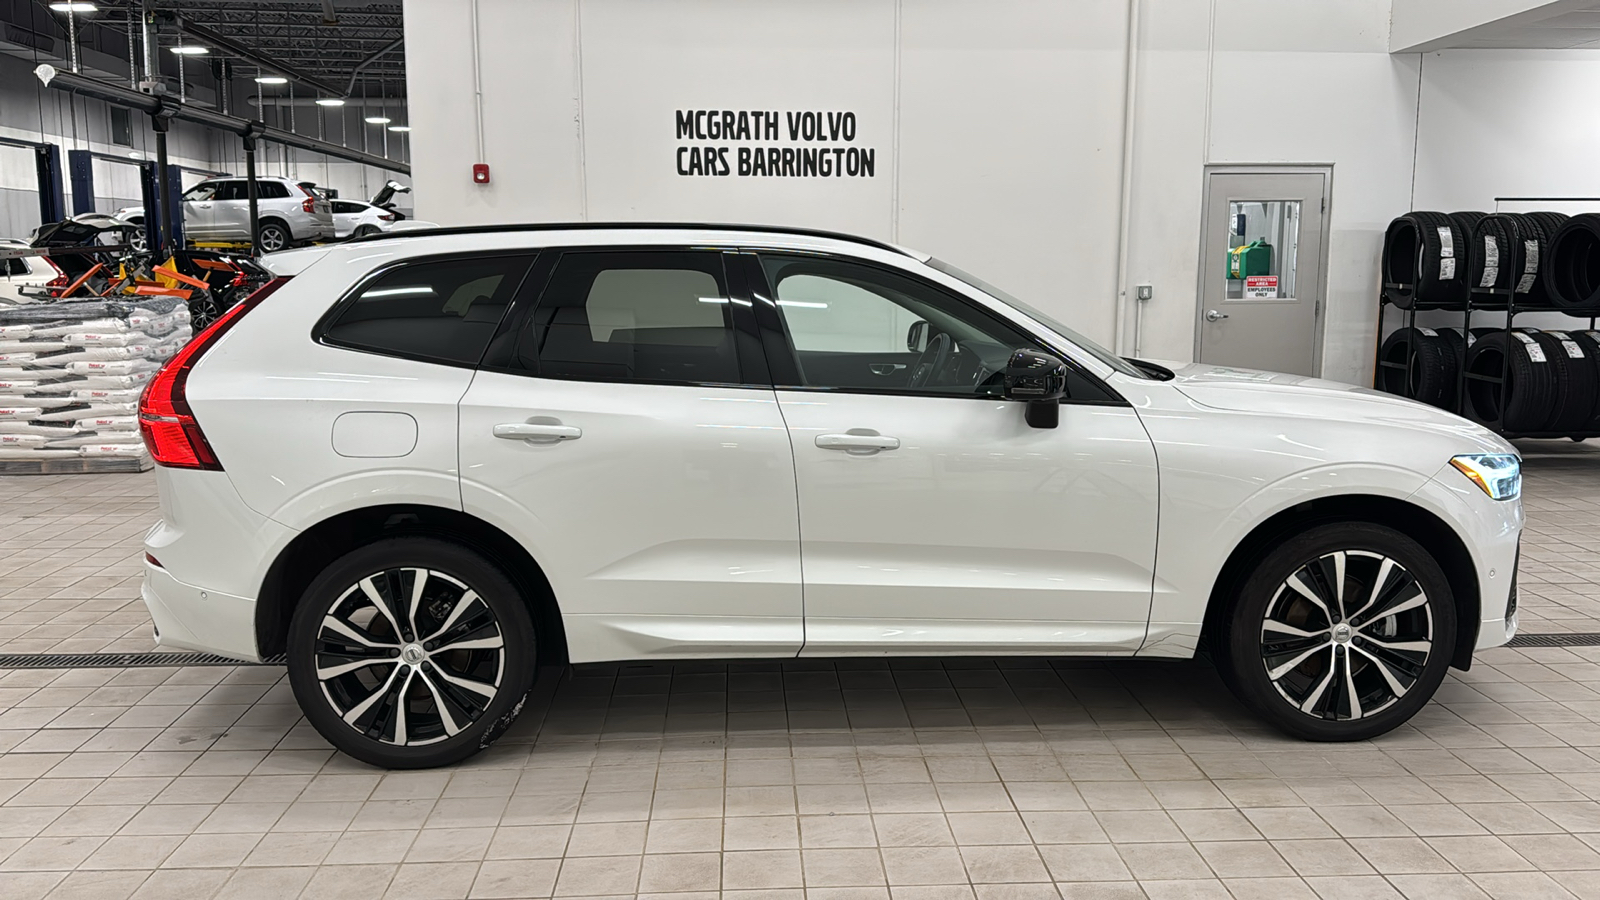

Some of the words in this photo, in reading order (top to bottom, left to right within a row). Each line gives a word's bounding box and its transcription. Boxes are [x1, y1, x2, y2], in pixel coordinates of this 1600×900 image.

[675, 110, 779, 141] MCGRATH
[786, 111, 856, 142] VOLVO
[676, 146, 731, 176] CARS
[737, 147, 875, 177] BARRINGTON
